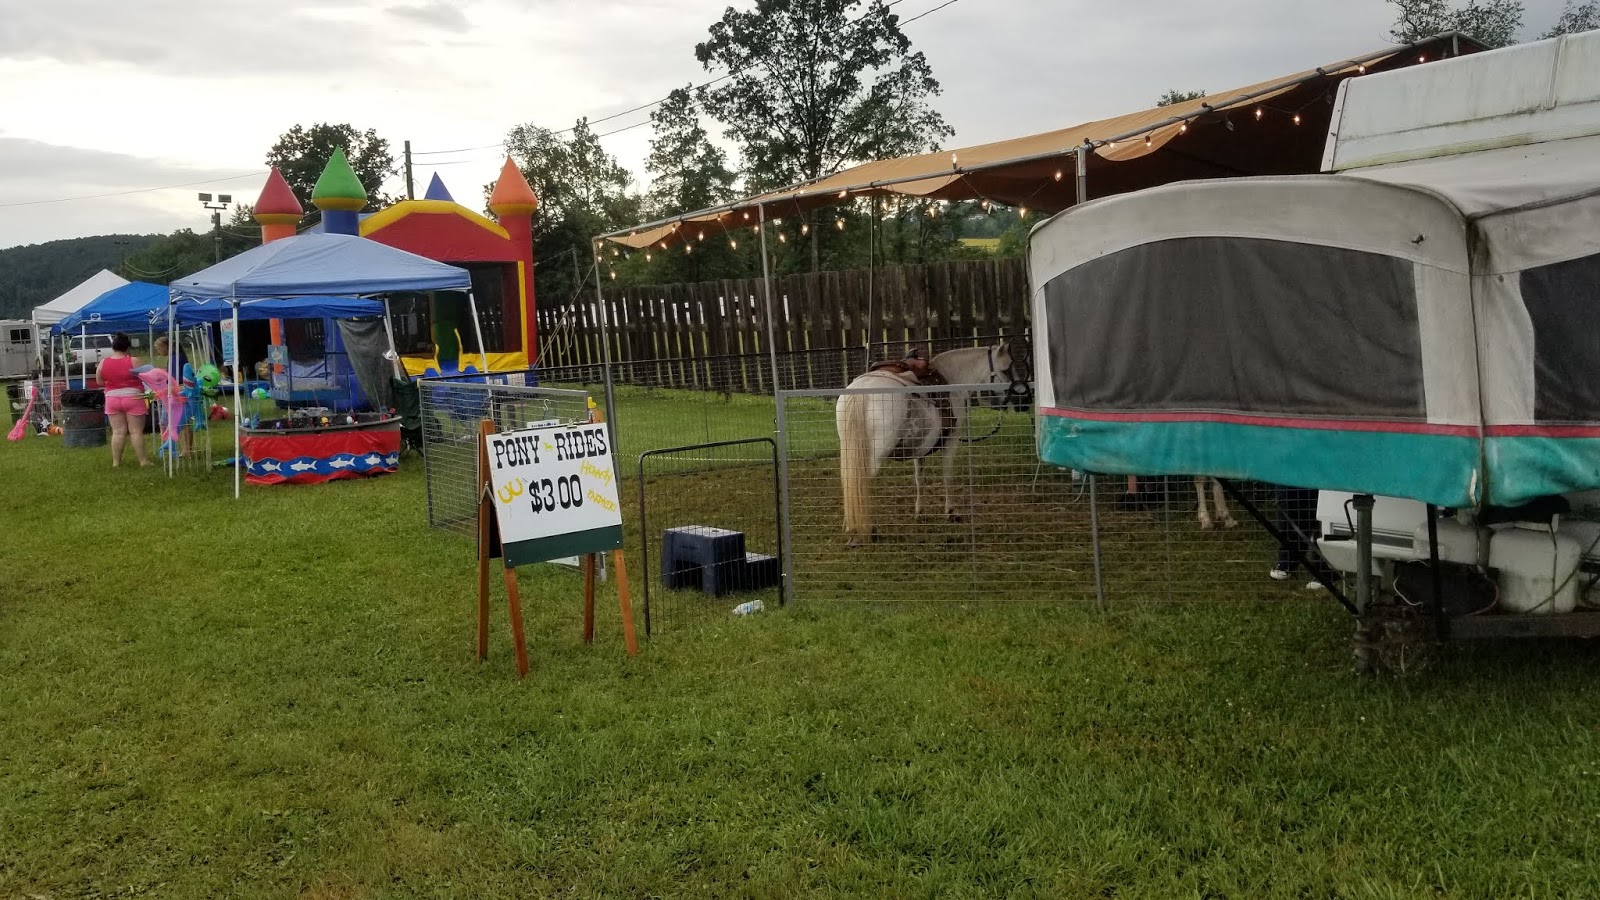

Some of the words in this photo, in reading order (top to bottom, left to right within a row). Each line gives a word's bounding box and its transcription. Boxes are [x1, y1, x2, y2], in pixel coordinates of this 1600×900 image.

[493, 435, 540, 469] PONY
[554, 428, 607, 461] RIDES
[529, 474, 583, 514] $3.00
